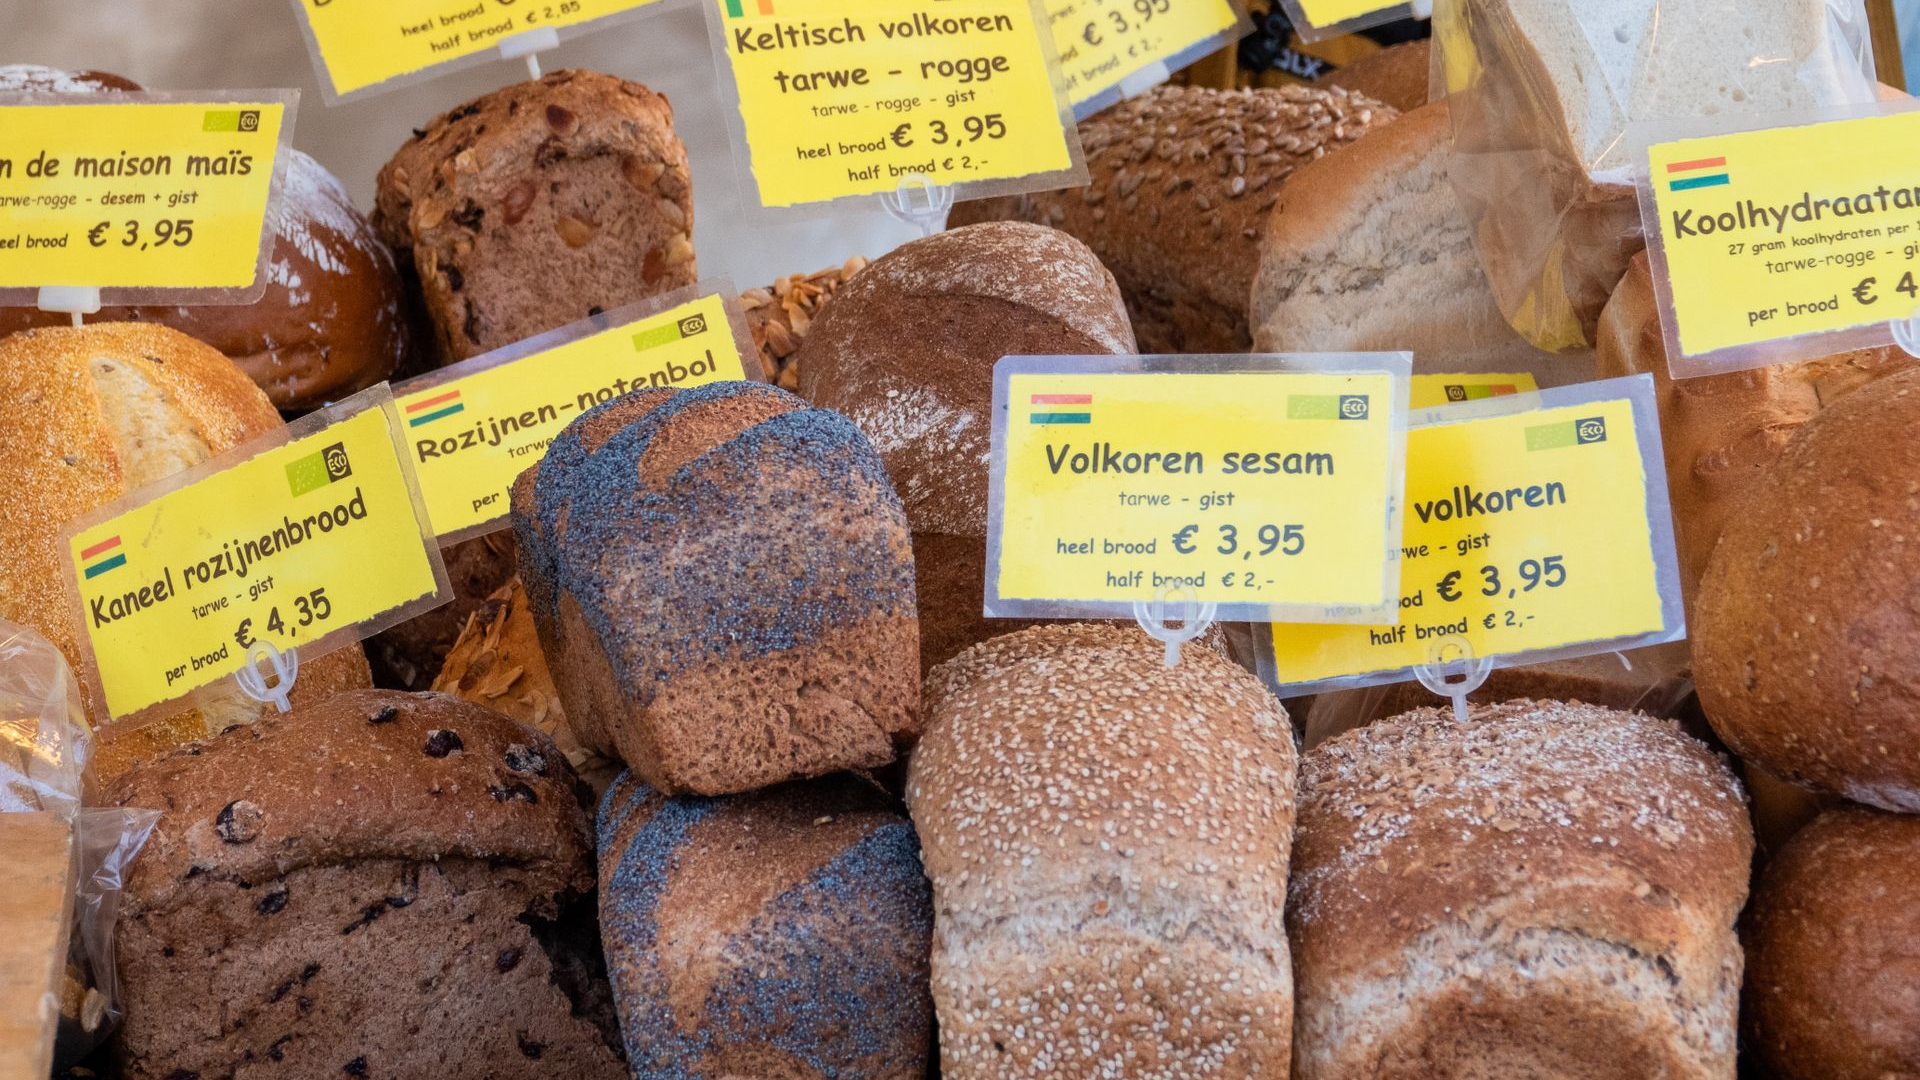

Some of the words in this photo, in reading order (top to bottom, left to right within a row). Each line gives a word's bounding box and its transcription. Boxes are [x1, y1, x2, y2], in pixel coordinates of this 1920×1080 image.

[401, 19, 433, 36] heel
[439, 2, 485, 26] brood
[430, 34, 460, 52] half
[468, 18, 513, 41] brood
[543, 0, 580, 19] 2,85
[734, 18, 865, 54] Keltisch
[878, 12, 1013, 38] volkoren
[774, 68, 869, 93] tarwe
[920, 56, 1010, 83] rogge
[811, 104, 858, 116] tarwe
[876, 97, 921, 113] rogge
[946, 89, 975, 107] gist
[796, 143, 831, 159] heel
[838, 137, 886, 154] brood
[890, 123, 913, 147] €
[929, 113, 1006, 147] 3,95
[26, 150, 59, 177] de
[74, 150, 171, 178] maison
[186, 150, 253, 176] maïs
[848, 165, 880, 181] half
[888, 159, 936, 177] brood
[942, 157, 954, 170] €
[100, 191, 145, 205] desem
[168, 190, 199, 207] gist
[26, 233, 68, 248] brood
[87, 221, 110, 247] €
[121, 219, 193, 251] 3,95
[1728, 243, 1745, 255] 27
[1752, 241, 1786, 255] gram
[1791, 228, 1881, 247] koolhydraten
[1887, 225, 1909, 237] per
[1765, 250, 1875, 273] tarwe-rogge
[1748, 308, 1778, 327] per
[1786, 294, 1839, 316] brood
[1852, 277, 1878, 305] €
[416, 350, 717, 463] Rozijnen-notenbol
[1046, 442, 1203, 474] Volkoren
[1222, 452, 1334, 475] sesam
[472, 493, 499, 513] per
[1118, 491, 1170, 506] tarwe
[1200, 490, 1235, 511] gist
[1414, 482, 1566, 523] volkoren
[90, 566, 174, 628] Kaneel
[183, 487, 368, 590] rozijnenbrood
[1057, 538, 1094, 554] heel
[1104, 538, 1156, 554] brood
[1172, 524, 1198, 554] €
[1217, 524, 1304, 560] 3,95
[1457, 533, 1490, 556] gist
[1106, 570, 1143, 588] half
[1152, 571, 1205, 588] brood
[1221, 572, 1235, 587] €
[1244, 572, 1274, 590] 2,-
[1436, 570, 1462, 602] €
[1480, 555, 1566, 599] 3,95
[192, 597, 229, 620] tarwe
[249, 575, 273, 602] gist
[165, 664, 187, 686] per
[190, 642, 228, 671] brood
[234, 618, 256, 649] €
[267, 587, 331, 637] 4,35
[1370, 625, 1406, 645] half
[1415, 616, 1468, 639] brood
[1483, 613, 1496, 629] €
[1504, 610, 1534, 628] 2,-
